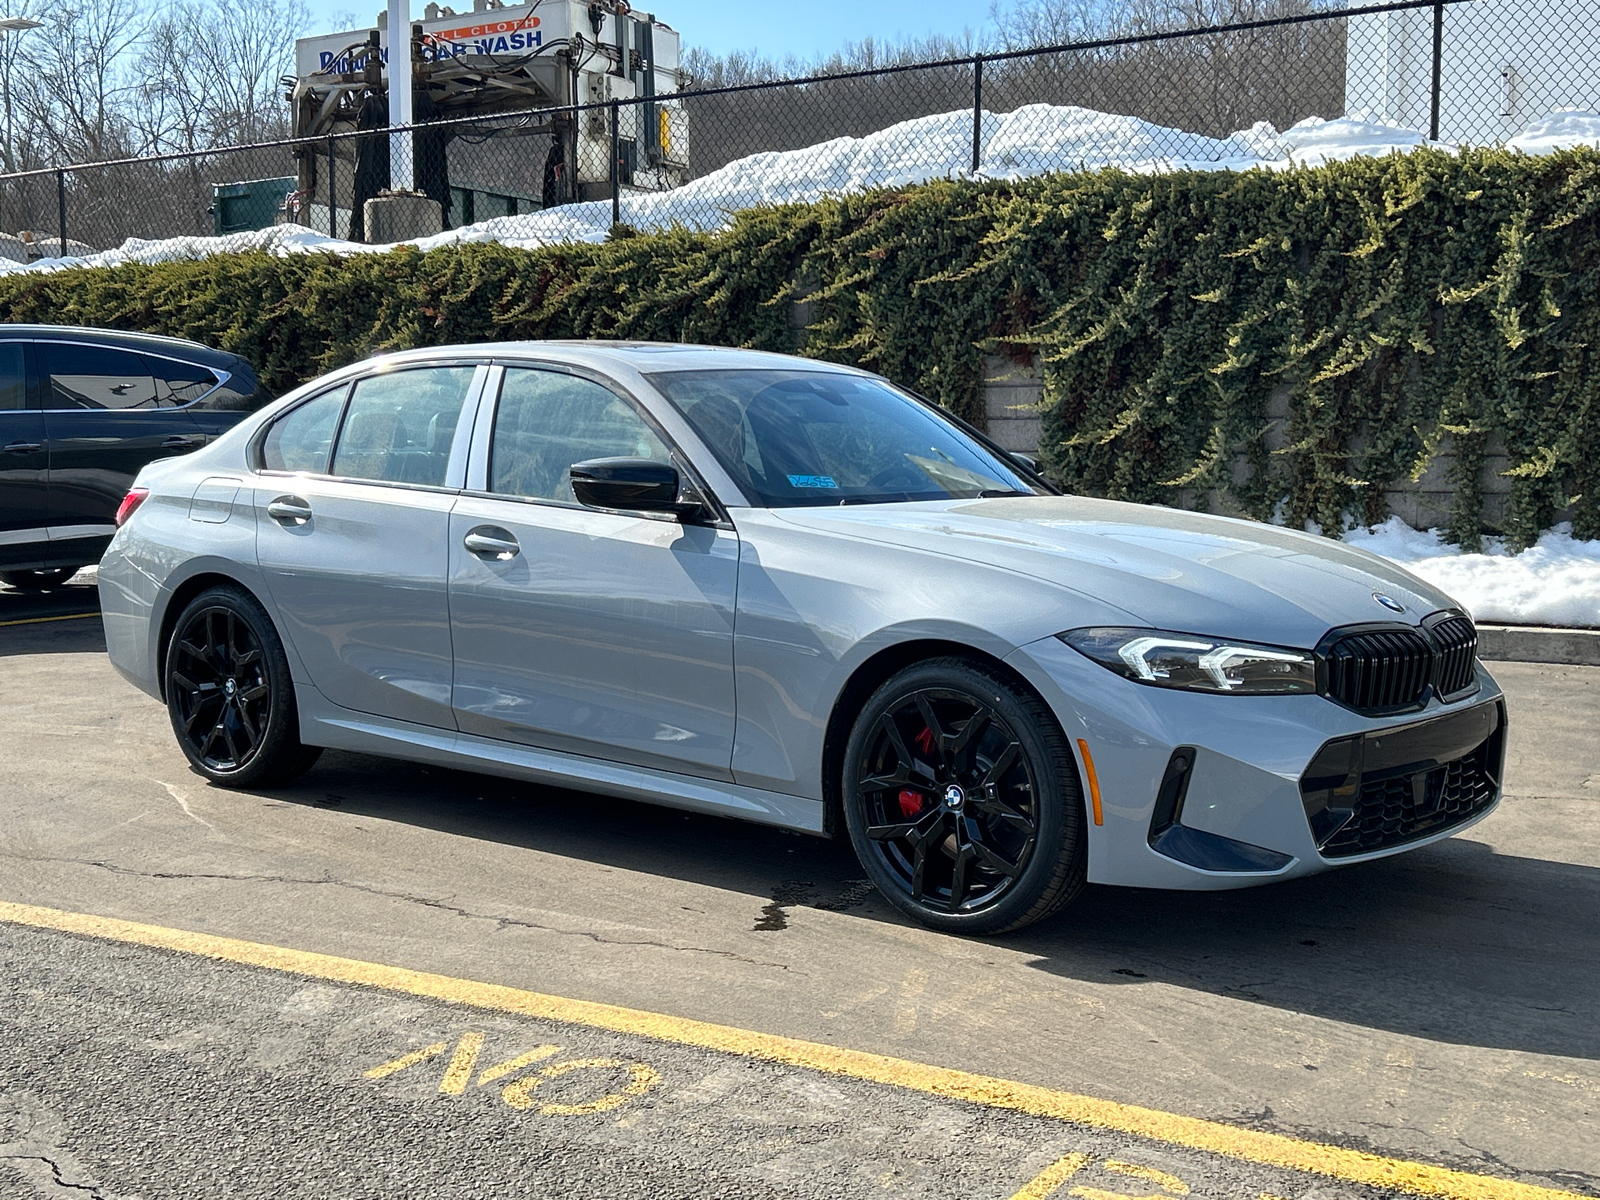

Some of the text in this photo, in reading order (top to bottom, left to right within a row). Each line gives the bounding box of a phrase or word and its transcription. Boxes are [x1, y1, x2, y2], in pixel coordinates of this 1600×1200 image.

[471, 18, 535, 36] CLOTH
[474, 31, 542, 56] WASH
[361, 1030, 662, 1115] NO
